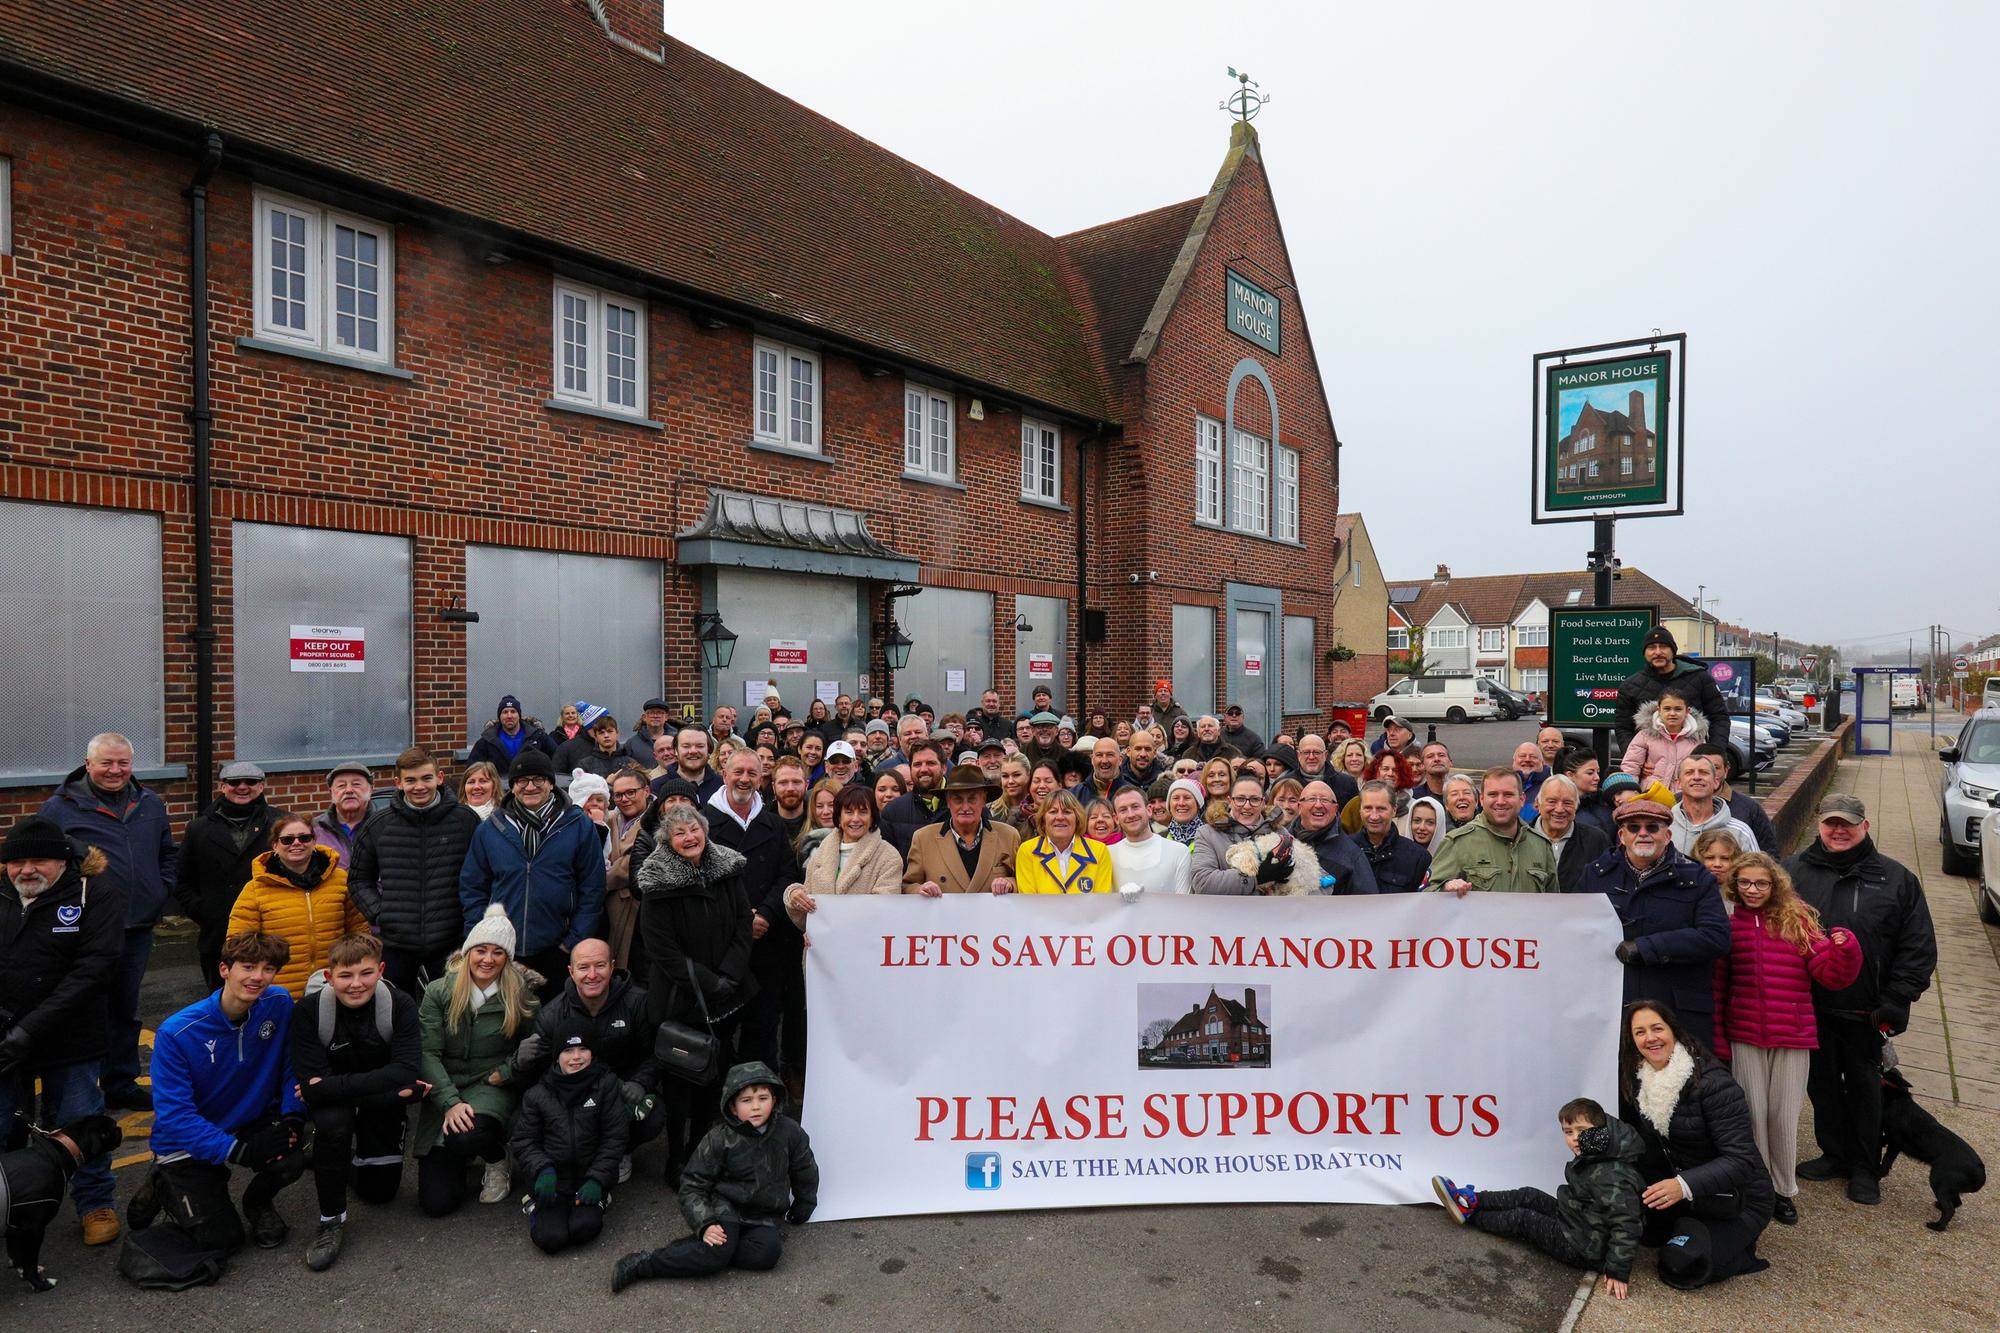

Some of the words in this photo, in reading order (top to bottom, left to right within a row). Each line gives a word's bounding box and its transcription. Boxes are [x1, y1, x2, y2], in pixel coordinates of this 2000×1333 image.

[1234, 282, 1274, 320] MANOR
[1236, 308, 1272, 341] HOUSE
[1559, 371, 1607, 385] MANOR
[1612, 365, 1657, 378] HOUSE
[1583, 493, 1626, 501] PORTSMOUTH
[1561, 620, 1583, 628] Food
[1585, 619, 1616, 627] Served
[1619, 618, 1643, 628] Daily
[1573, 637, 1592, 645] Pool
[1594, 637, 1602, 645] &
[1605, 637, 1630, 645] Darts
[304, 642, 328, 650] KEEP
[330, 643, 350, 651] OUT
[1572, 655, 1594, 663] Beer
[1595, 655, 1629, 663] Garden
[1576, 673, 1595, 681] Live
[1597, 673, 1626, 681] Music
[1576, 690, 1592, 698] sky
[1594, 690, 1618, 698] sport
[881, 934, 981, 967] LETS
[992, 935, 1096, 967] SAVE
[1106, 934, 1199, 966] OUR
[1209, 935, 1377, 970] MANOR
[1388, 937, 1541, 970] HOUSE
[914, 1095, 1128, 1141] PLEASE
[1143, 1091, 1409, 1139] SUPPORT
[1425, 1094, 1500, 1138] US
[1011, 1160, 1068, 1178] SAVE
[1072, 1158, 1119, 1177] THE
[1124, 1156, 1211, 1176] MANOR
[1214, 1153, 1290, 1174] HOUSE
[1294, 1152, 1402, 1172] DRAYTON
